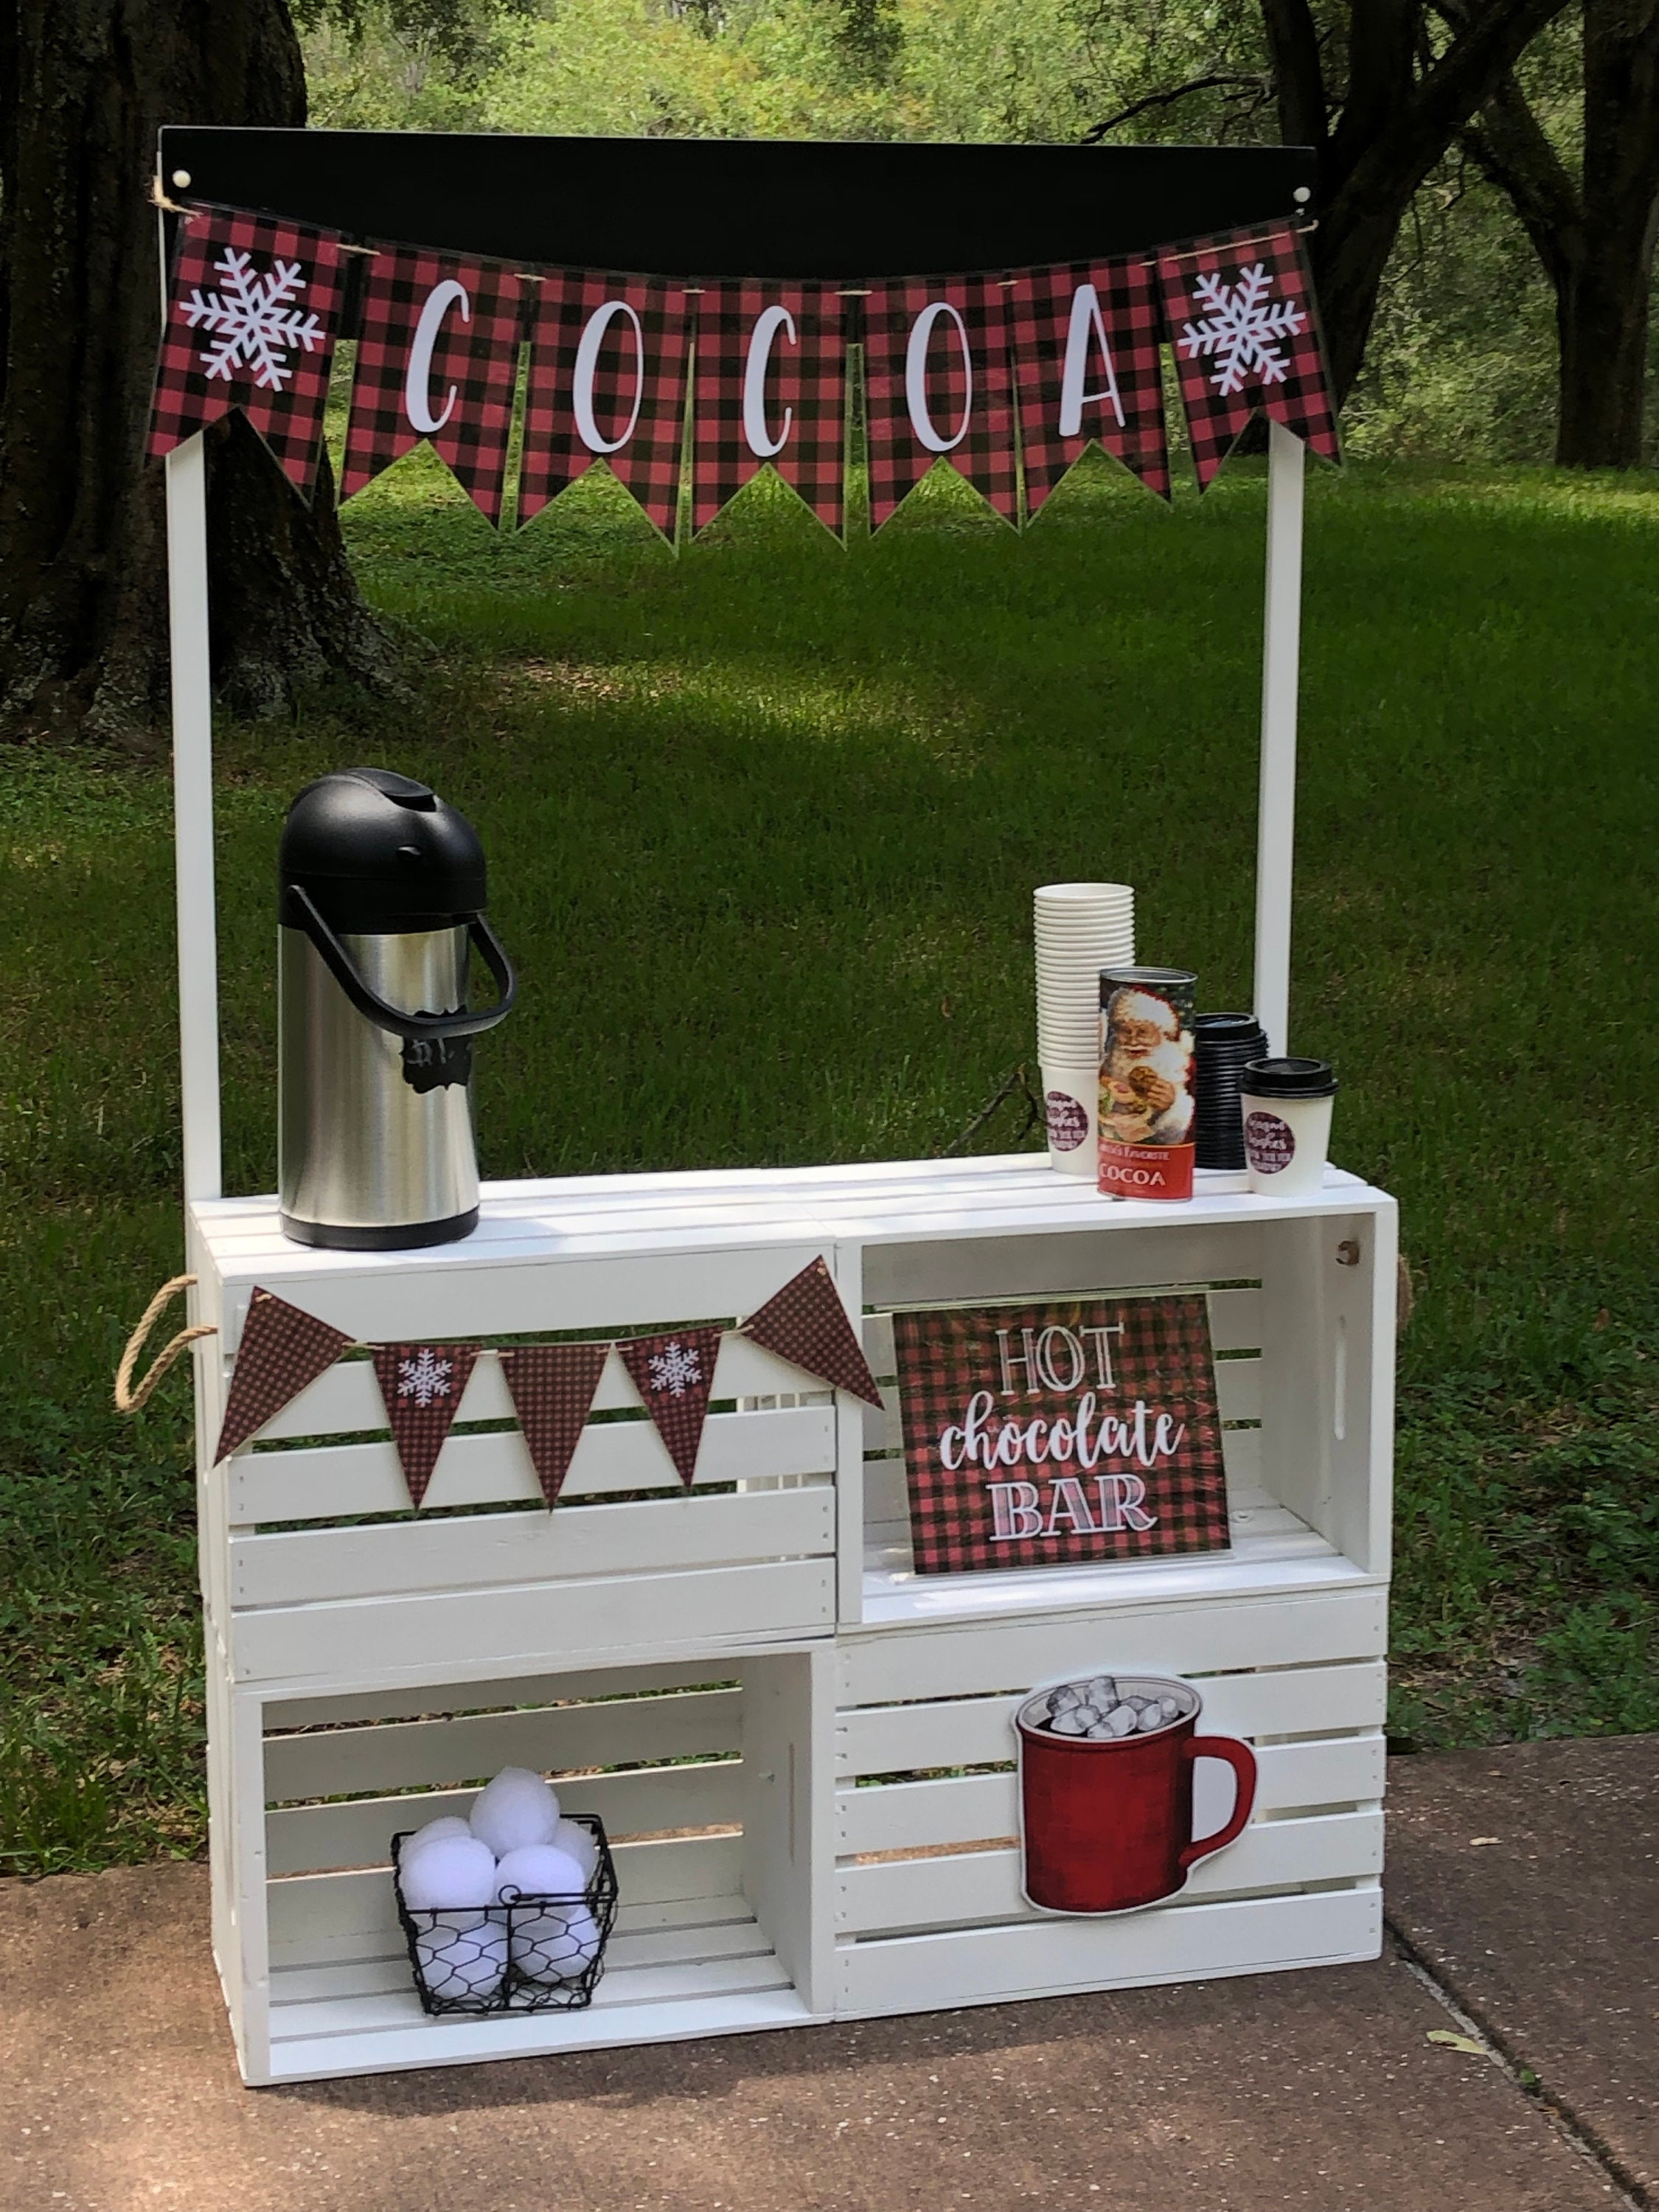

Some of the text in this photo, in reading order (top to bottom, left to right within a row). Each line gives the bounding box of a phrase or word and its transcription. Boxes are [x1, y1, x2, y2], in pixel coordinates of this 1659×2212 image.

[406, 279, 1126, 456] COCOA
[1099, 1163, 1166, 1186] COCOA
[995, 1322, 1125, 1396] HOT
[940, 1391, 1185, 1470] chocolate
[986, 1473, 1158, 1541] BAR
